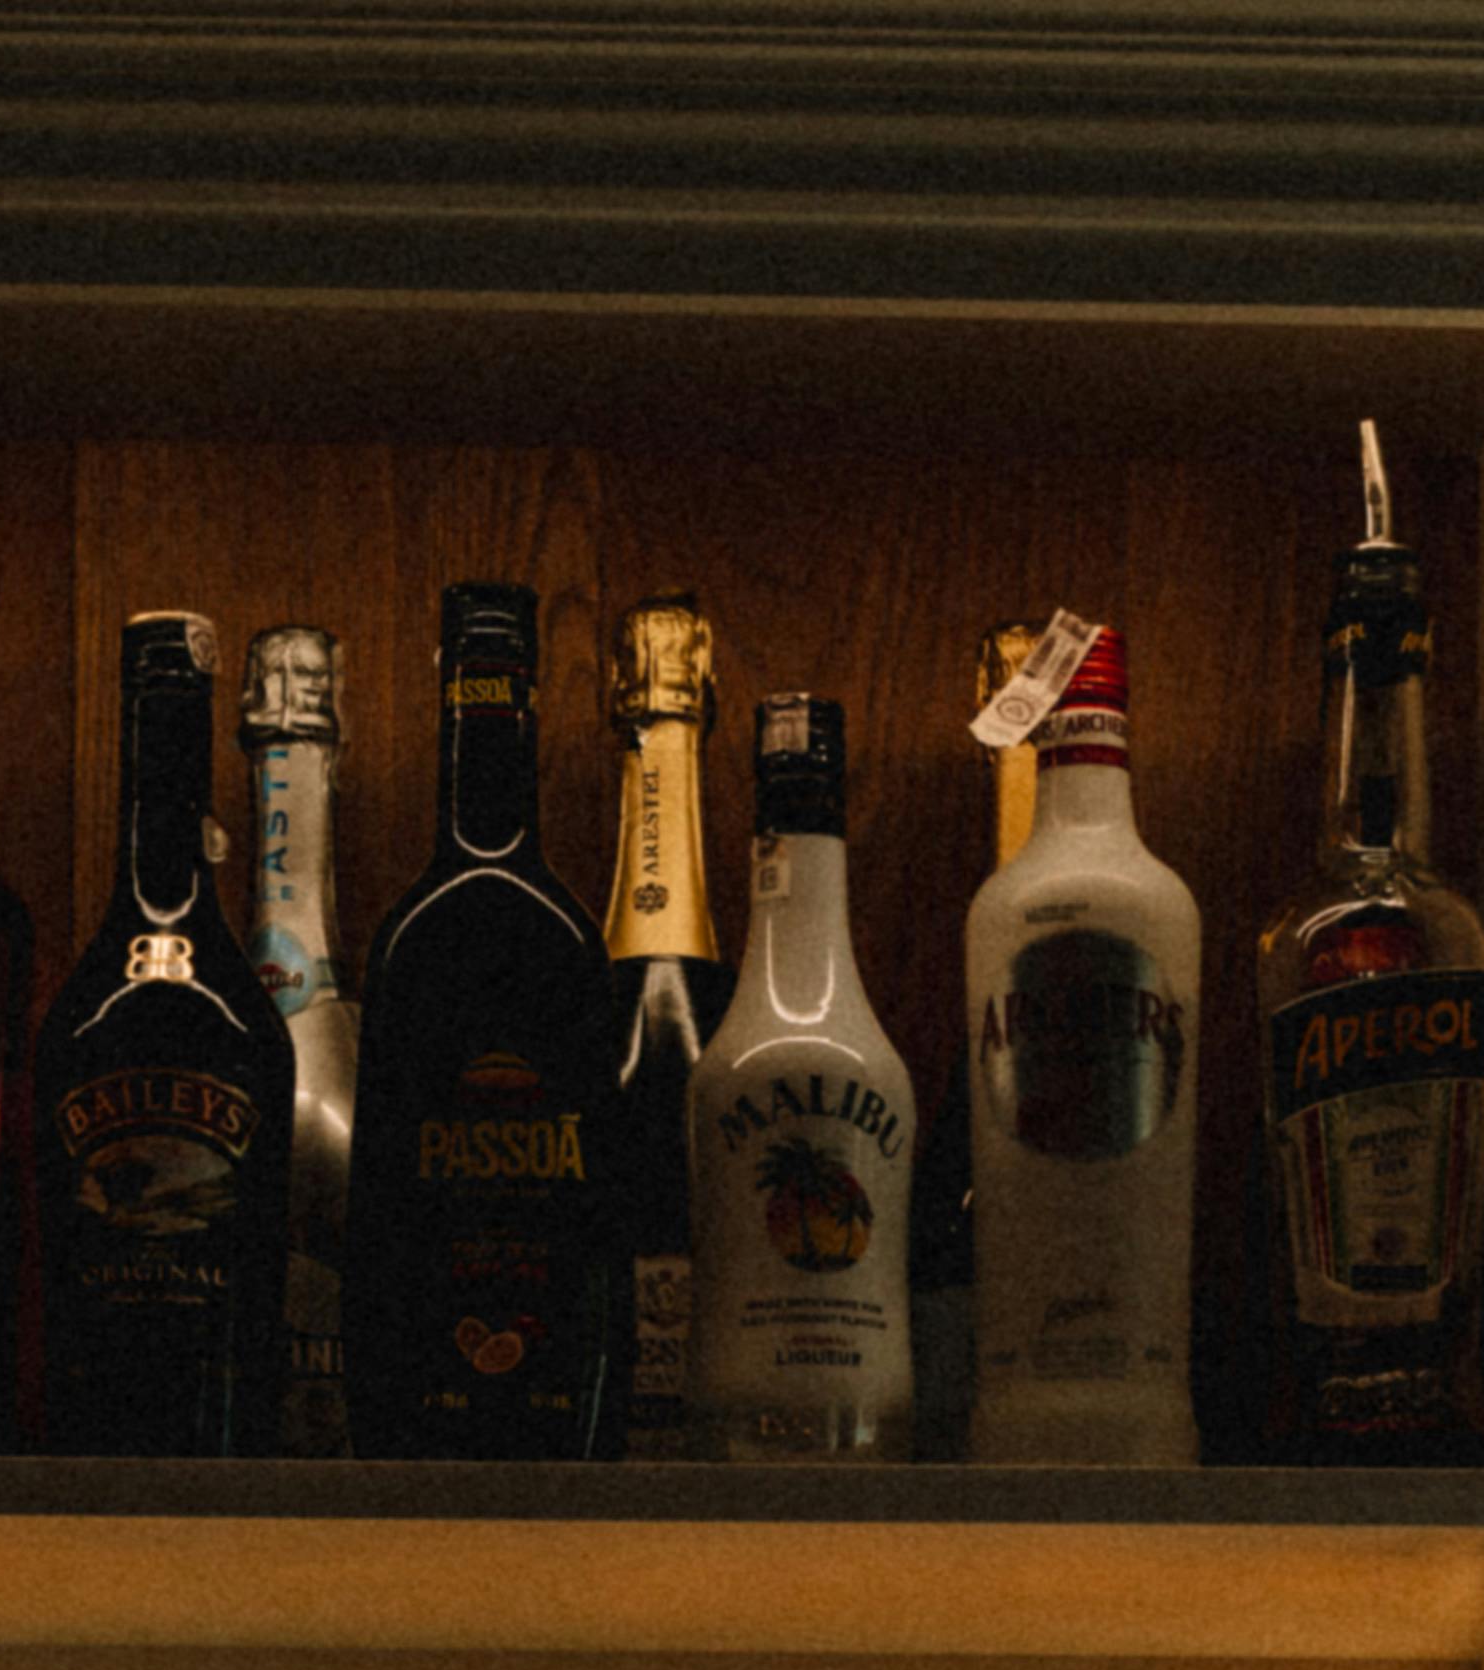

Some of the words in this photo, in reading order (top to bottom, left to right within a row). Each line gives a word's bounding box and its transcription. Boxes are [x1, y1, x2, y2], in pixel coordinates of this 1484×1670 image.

[262, 748, 289, 875] ASTI
[1293, 1000, 1479, 1091] APEROL
[66, 1078, 243, 1137] BAILEYS
[417, 1111, 588, 1182] PASSOÃ
[719, 1076, 904, 1158] MALIBU
